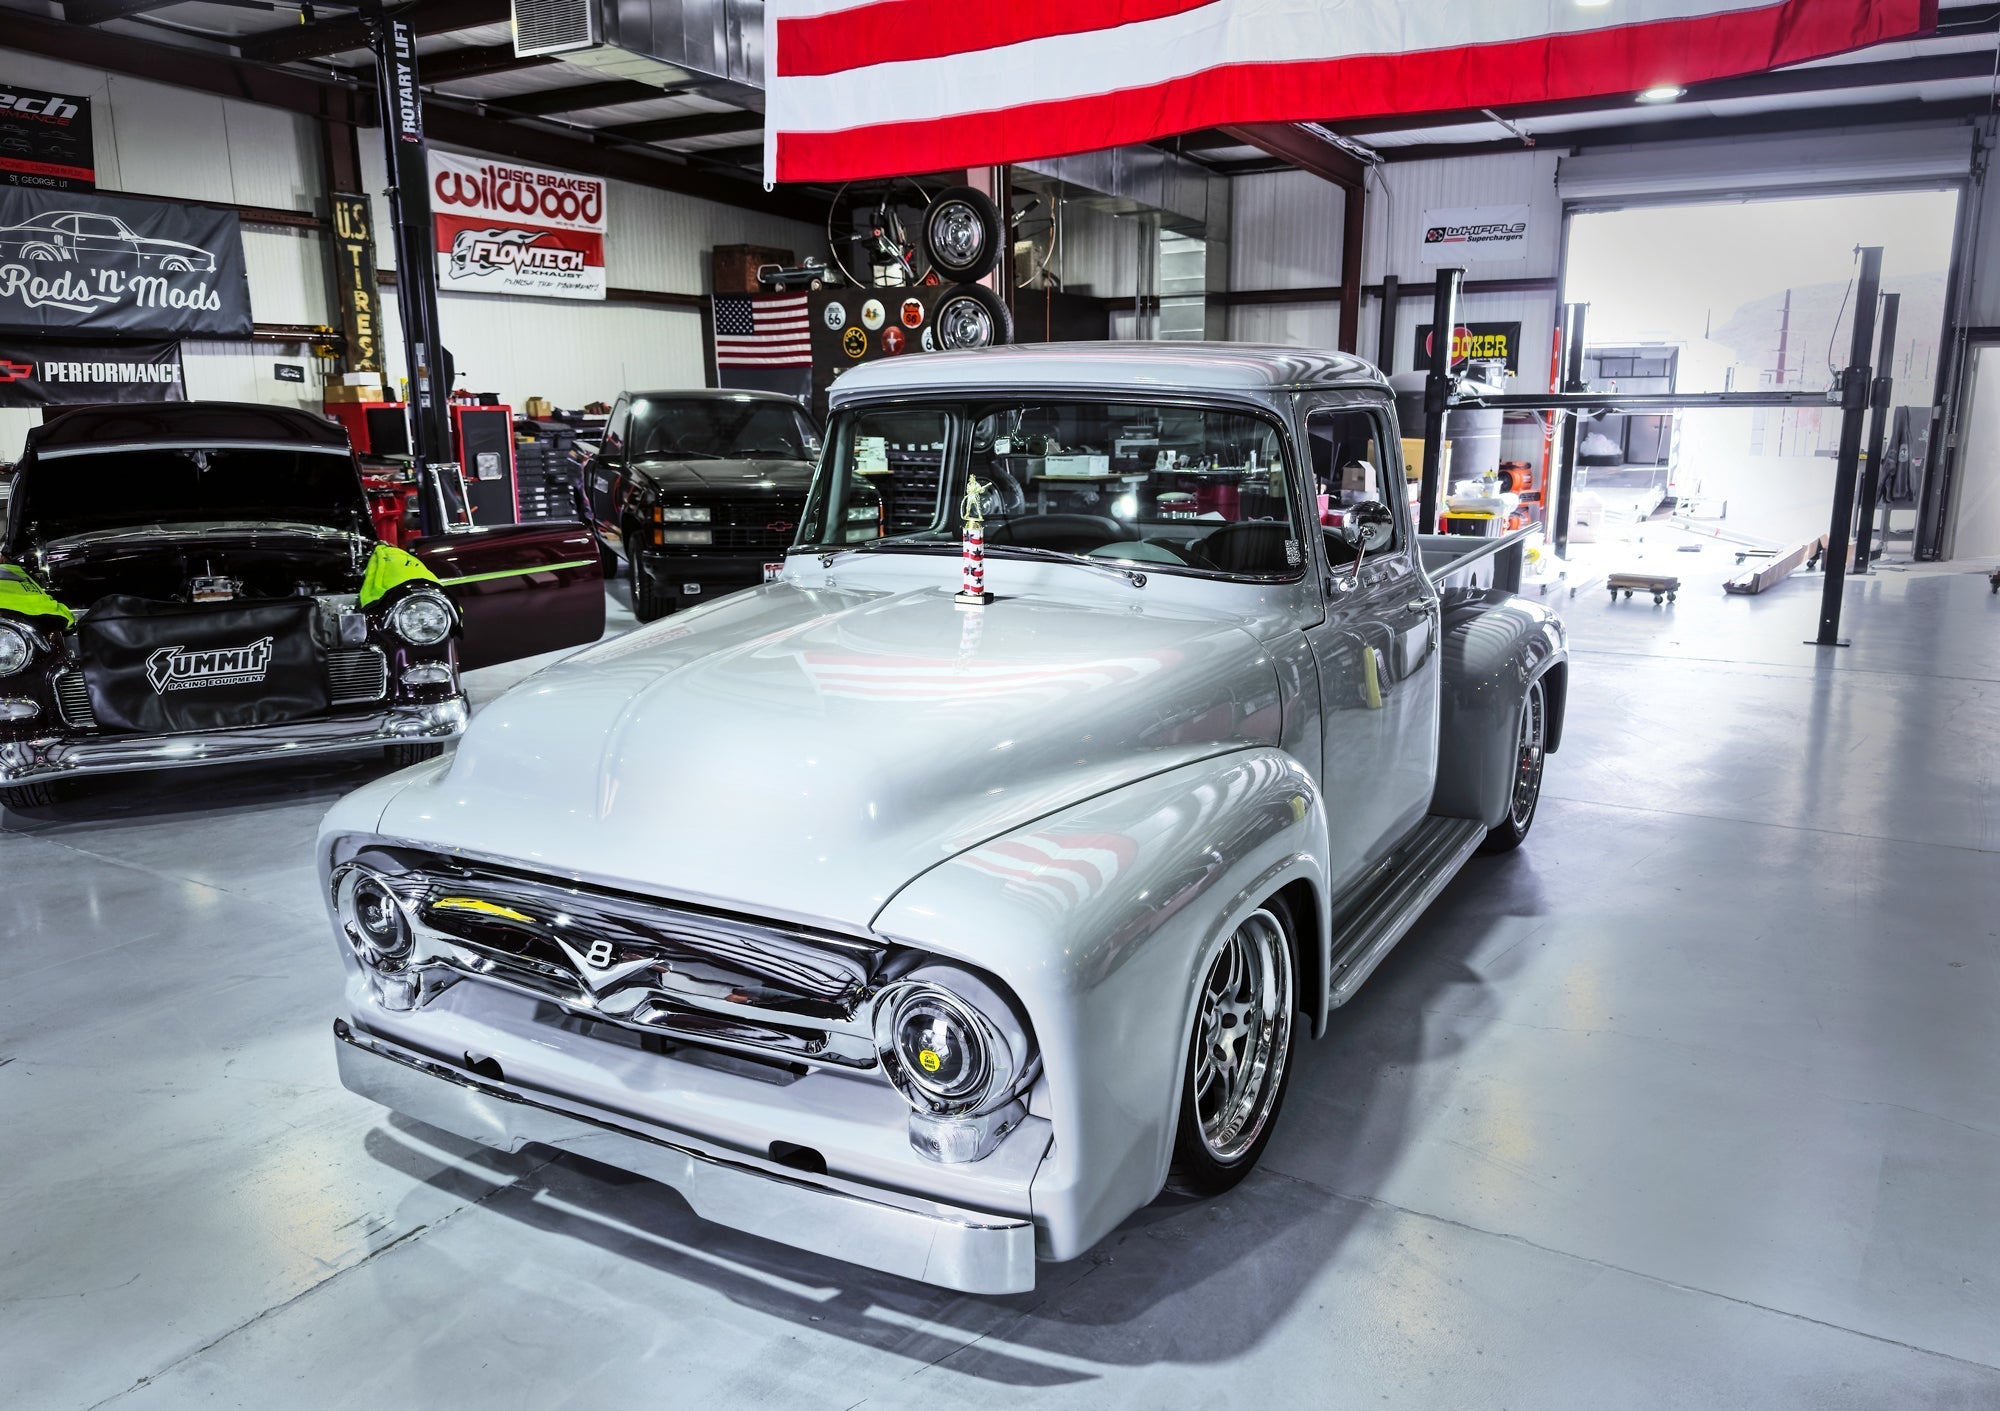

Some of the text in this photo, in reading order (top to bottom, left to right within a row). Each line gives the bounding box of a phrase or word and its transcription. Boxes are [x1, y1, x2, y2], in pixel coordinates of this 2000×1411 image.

[393, 20, 409, 59] LIFT
[397, 62, 416, 133] ROTARY
[497, 167, 597, 193] DISC BRAKES
[435, 165, 602, 224] wilwood
[336, 202, 370, 241] U.S.
[1446, 223, 1526, 237] WHIPPLE
[1467, 234, 1523, 242] Superchargers
[471, 240, 586, 275] FLOWTECH
[522, 269, 584, 279] EXHAUST
[0, 264, 121, 314] Rods
[128, 275, 221, 311] Mods
[347, 244, 374, 358] TIRES
[828, 313, 842, 325] 66
[905, 314, 918, 323] 66
[925, 338, 933, 350] 6
[1452, 334, 1508, 357] OOKER
[44, 361, 182, 383] PERFORMANCE
[168, 674, 266, 691] RACING EQUIPMENT
